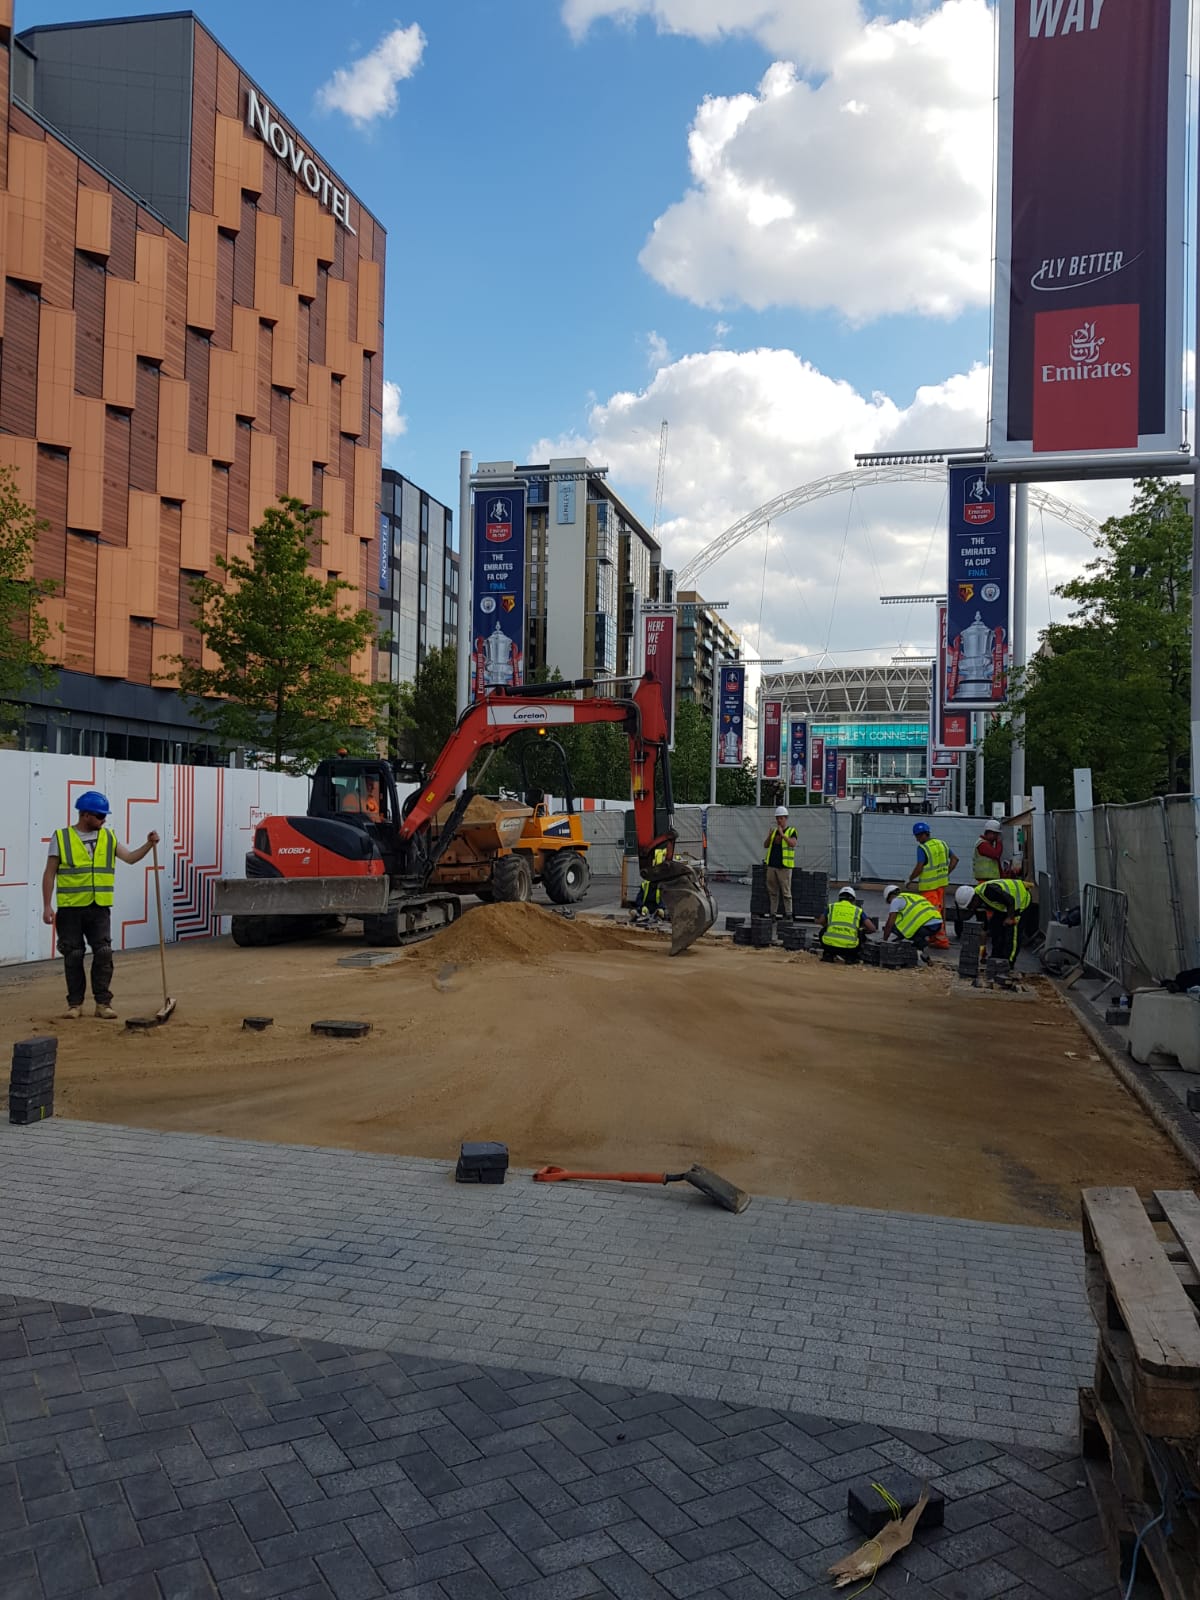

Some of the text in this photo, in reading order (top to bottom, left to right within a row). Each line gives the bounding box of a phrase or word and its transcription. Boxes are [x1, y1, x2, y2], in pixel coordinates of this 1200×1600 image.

[1028, 0, 1108, 39] WAY
[248, 89, 357, 237] NOVOTEL
[1039, 250, 1124, 279] FLY BETTER
[1041, 360, 1132, 383] Emirates
[971, 537, 985, 545] THE
[961, 547, 997, 556] EMIRATES
[483, 563, 513, 571] EMIRATES
[965, 558, 991, 567] FA CUP
[487, 573, 495, 581] FA
[968, 569, 989, 577] FINAL
[648, 620, 665, 632] HERE
[648, 632, 659, 643] WE
[647, 644, 657, 656] GO
[826, 731, 928, 741] EMBLEY CONNECTE
